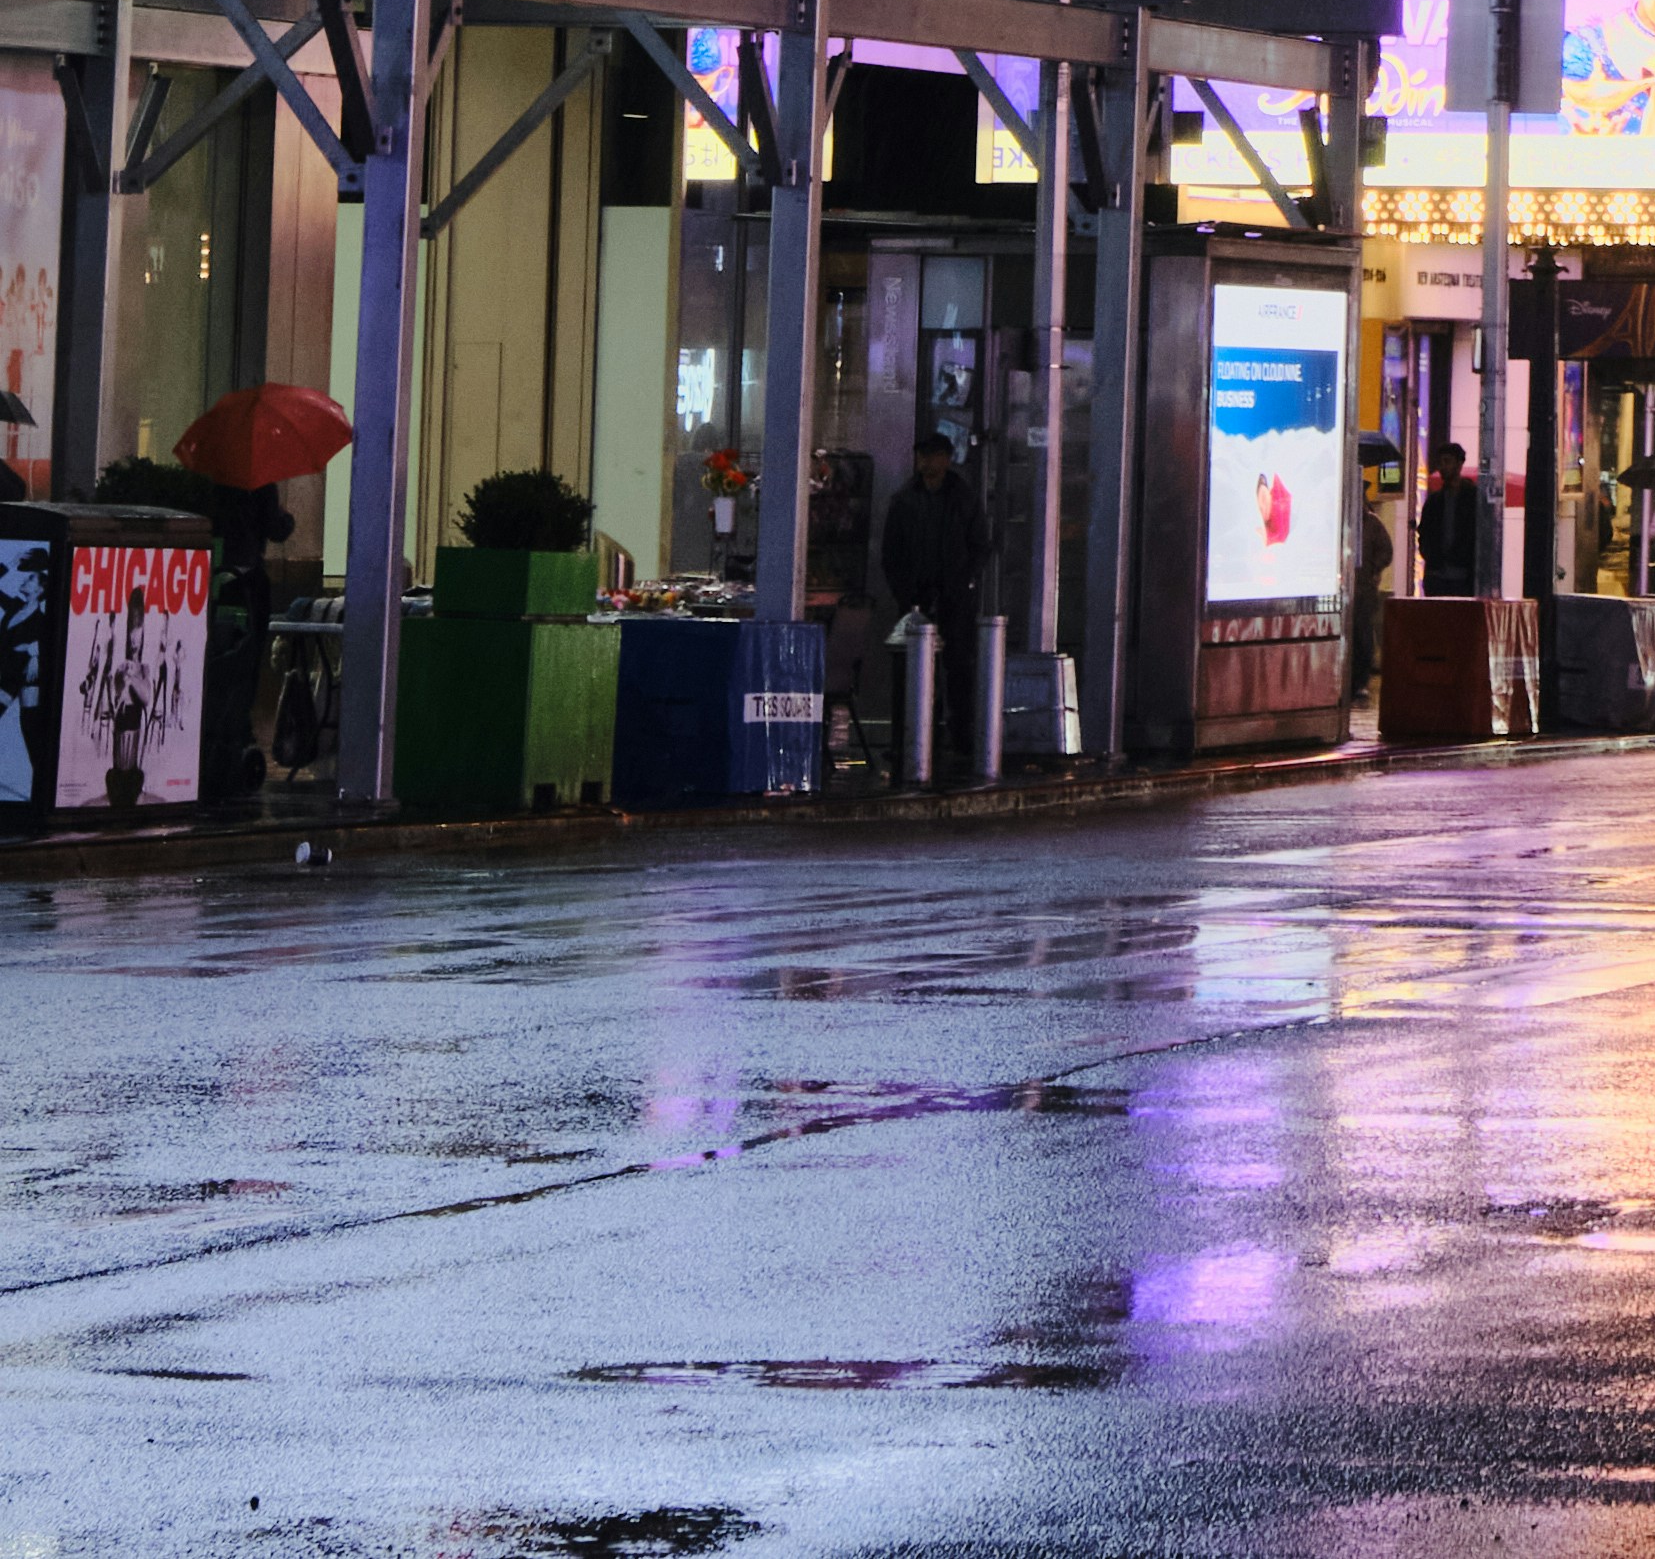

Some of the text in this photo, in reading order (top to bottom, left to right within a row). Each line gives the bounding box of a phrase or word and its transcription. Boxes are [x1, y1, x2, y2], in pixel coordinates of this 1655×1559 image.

[1565, 299, 1613, 320] Disney
[1216, 390, 1256, 409] BUSINESS
[70, 546, 211, 617] CHICAGO
